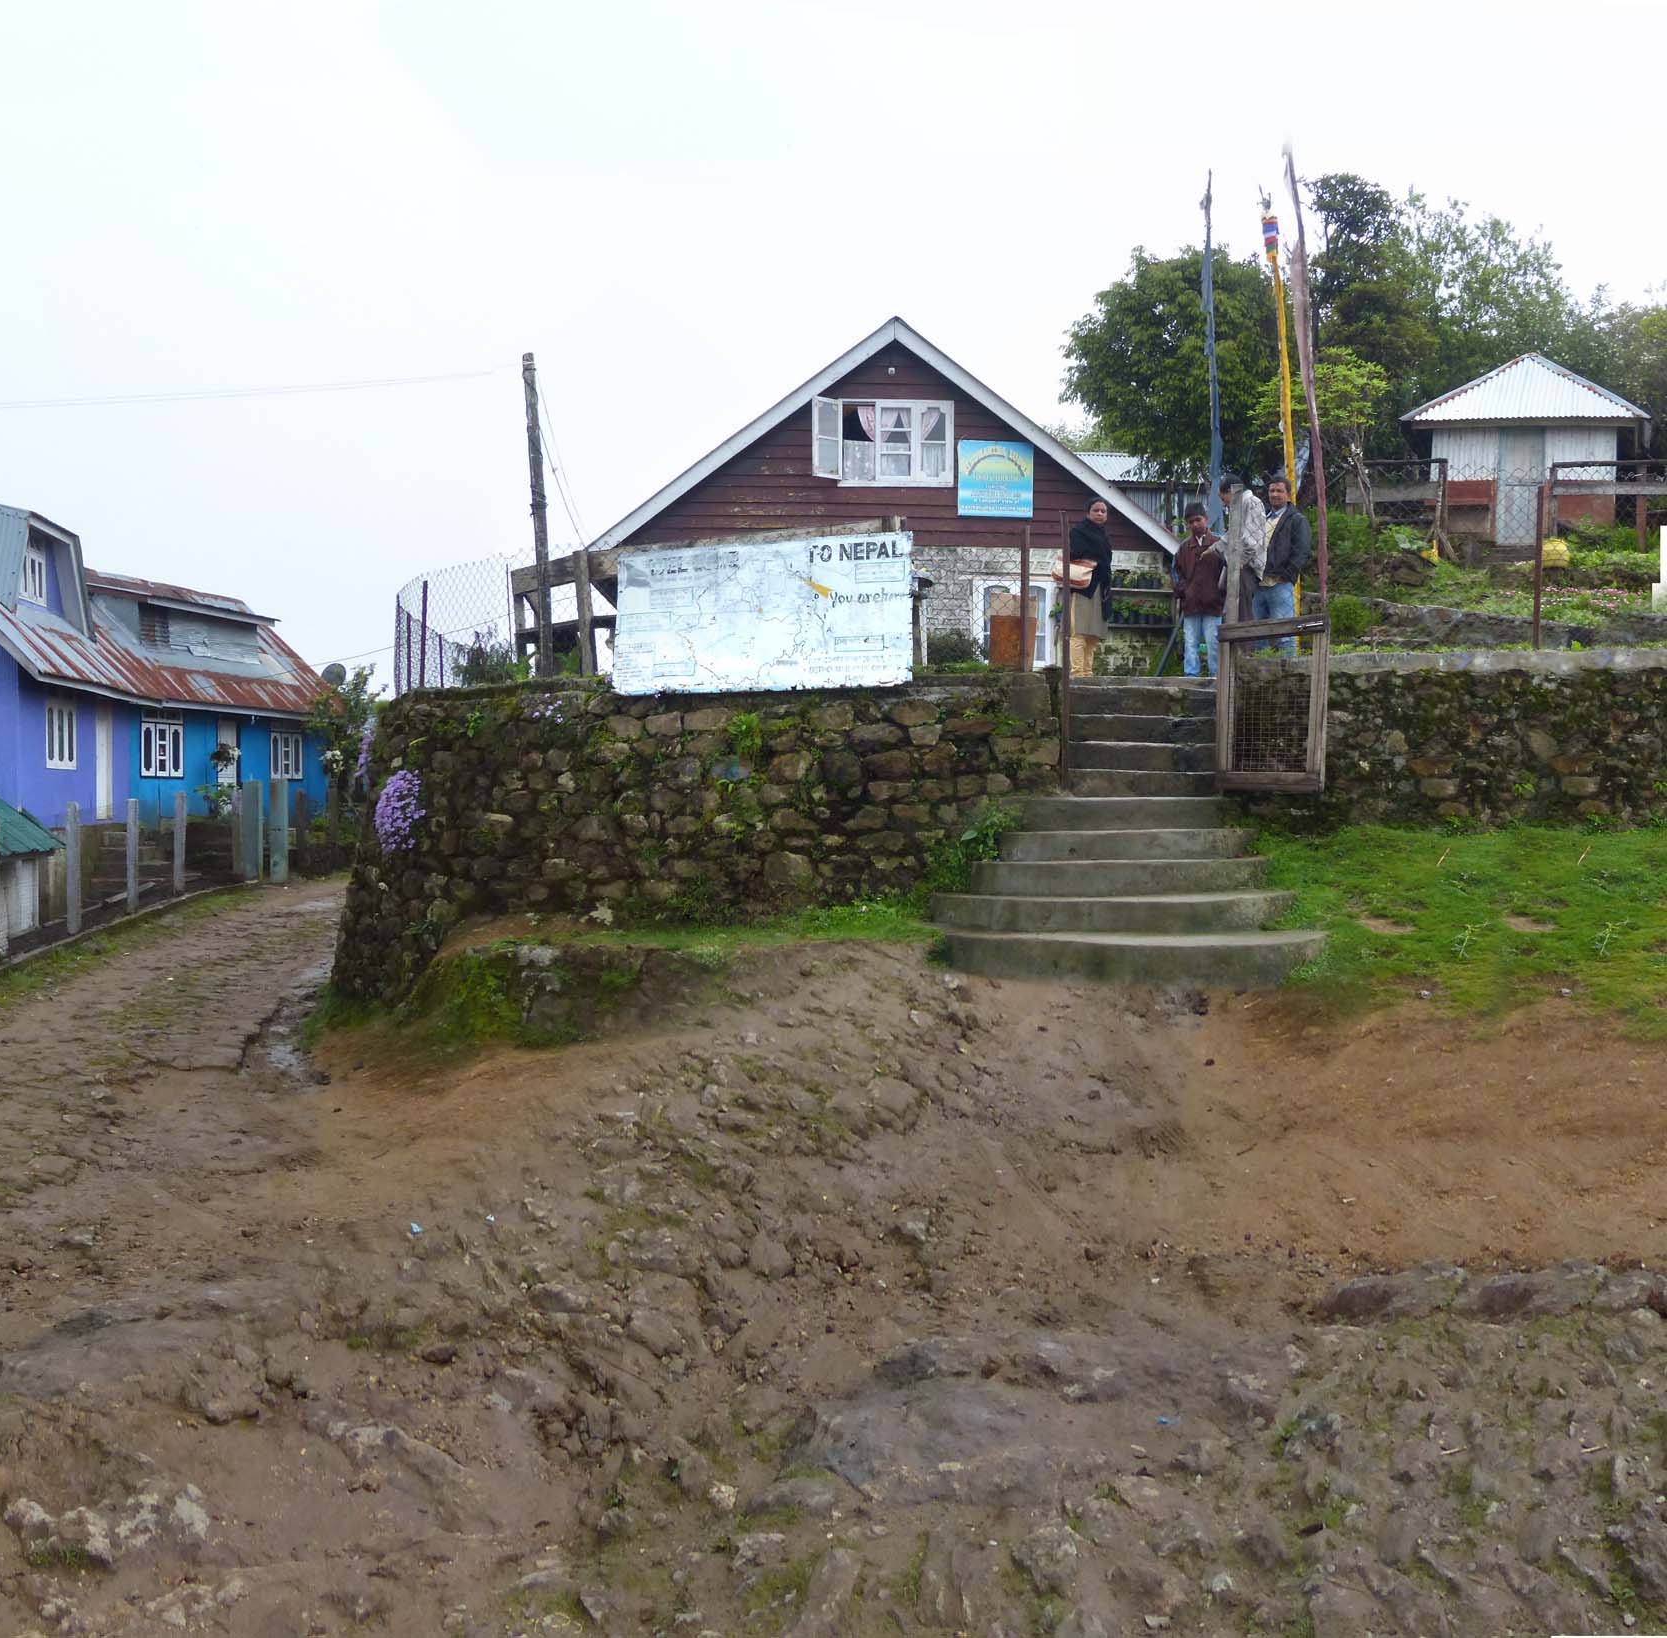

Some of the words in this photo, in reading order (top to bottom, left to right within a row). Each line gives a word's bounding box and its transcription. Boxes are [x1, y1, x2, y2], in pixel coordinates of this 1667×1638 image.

[809, 544, 832, 563] TO
[839, 540, 903, 561] NEPAL
[830, 591, 853, 608] You
